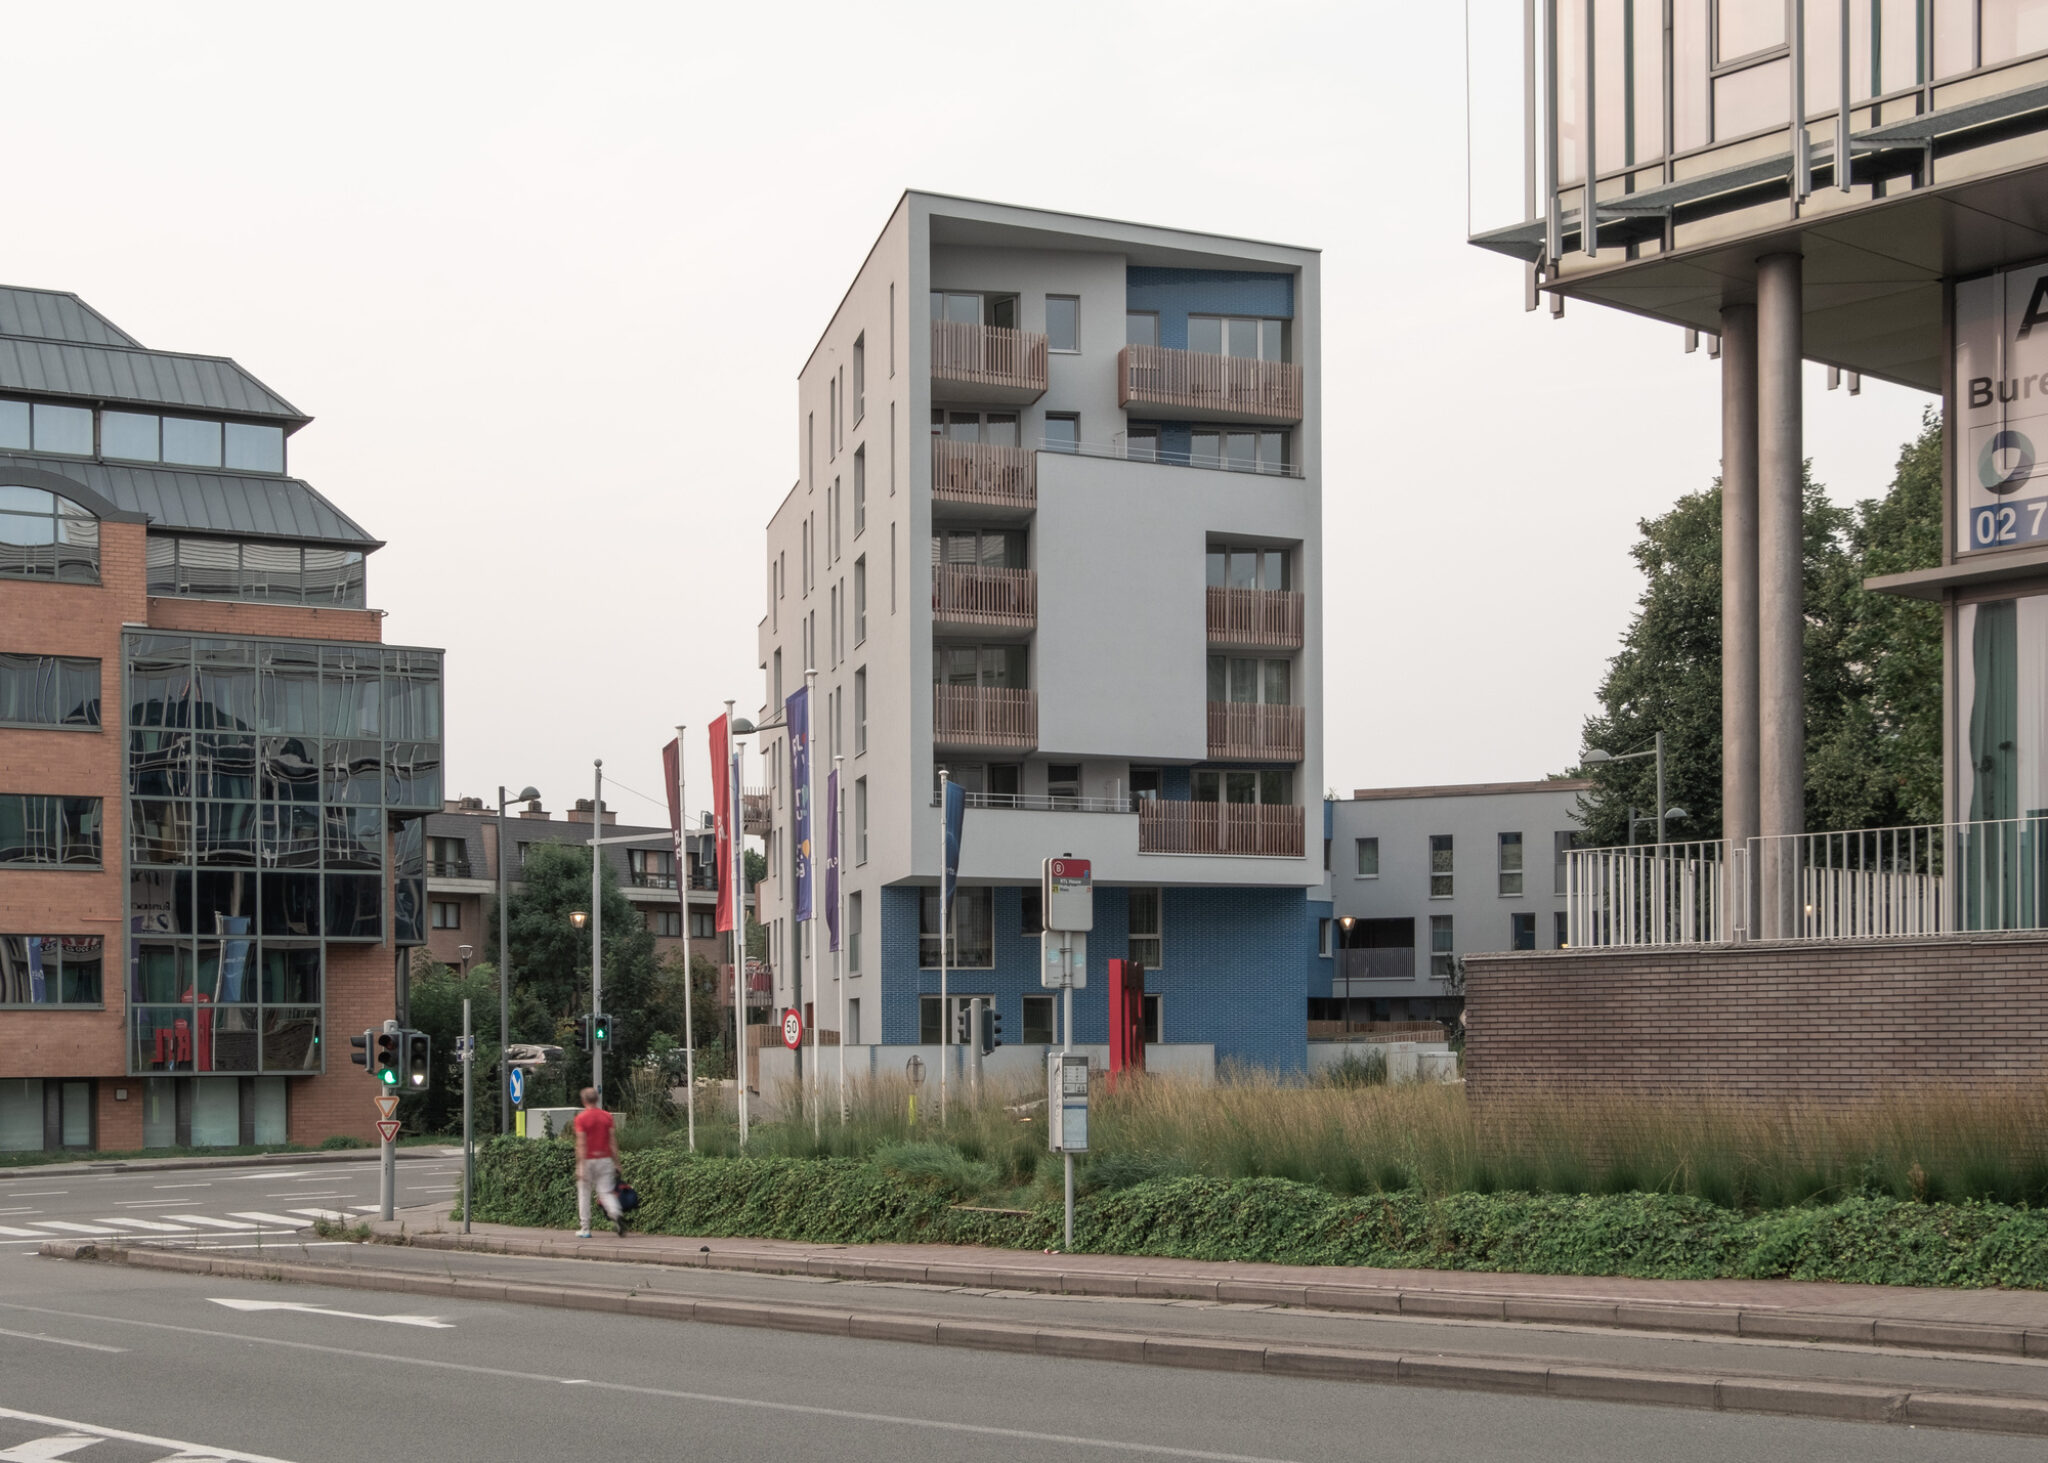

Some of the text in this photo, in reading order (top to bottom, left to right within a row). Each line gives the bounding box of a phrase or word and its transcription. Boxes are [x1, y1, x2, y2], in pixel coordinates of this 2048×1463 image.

[1977, 502, 2048, 544] 02 7
[787, 1020, 797, 1033] 50
